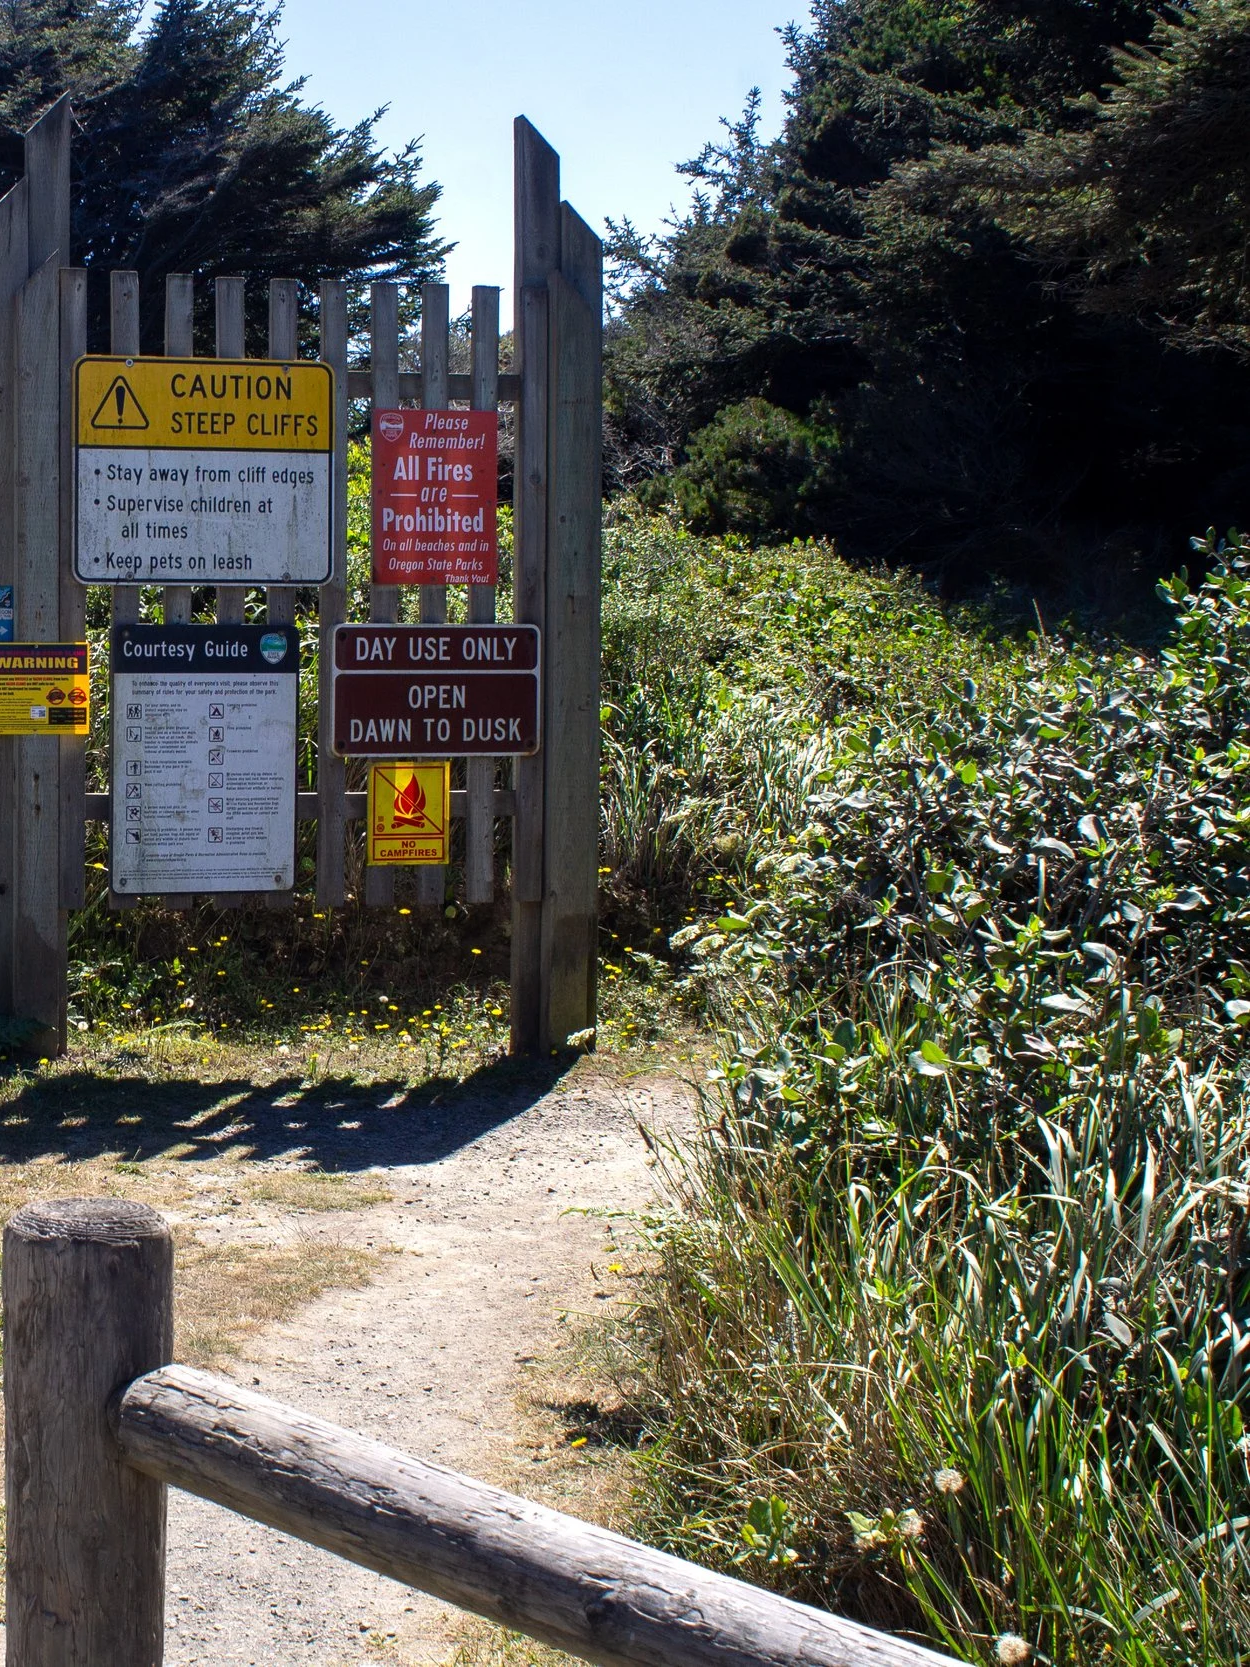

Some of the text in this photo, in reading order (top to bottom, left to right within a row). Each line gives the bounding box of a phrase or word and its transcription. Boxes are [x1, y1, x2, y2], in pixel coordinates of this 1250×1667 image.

[171, 374, 291, 400] CAUTION
[171, 412, 318, 436] STEEP CLIFFS
[425, 414, 468, 430] Please
[410, 433, 485, 450] Remember!
[107, 464, 314, 488] Stay away from cliff edges
[393, 456, 473, 482] All Fires
[421, 487, 447, 502] are
[107, 495, 273, 515] Supervise children at
[383, 507, 483, 532] Prohibited
[122, 523, 188, 538] all times
[383, 539, 489, 551] On all beaches and in
[106, 552, 252, 574] Keep pets on leash
[389, 558, 483, 573] Oregon State Parks
[445, 574, 489, 583] Thank You!
[123, 641, 248, 661] Courtesy Guide
[356, 637, 517, 661] DAY USE ONLY
[409, 685, 465, 709] OPEN
[350, 718, 521, 743] DAWN TO DUSK
[380, 849, 437, 857] CAMPFIRES
